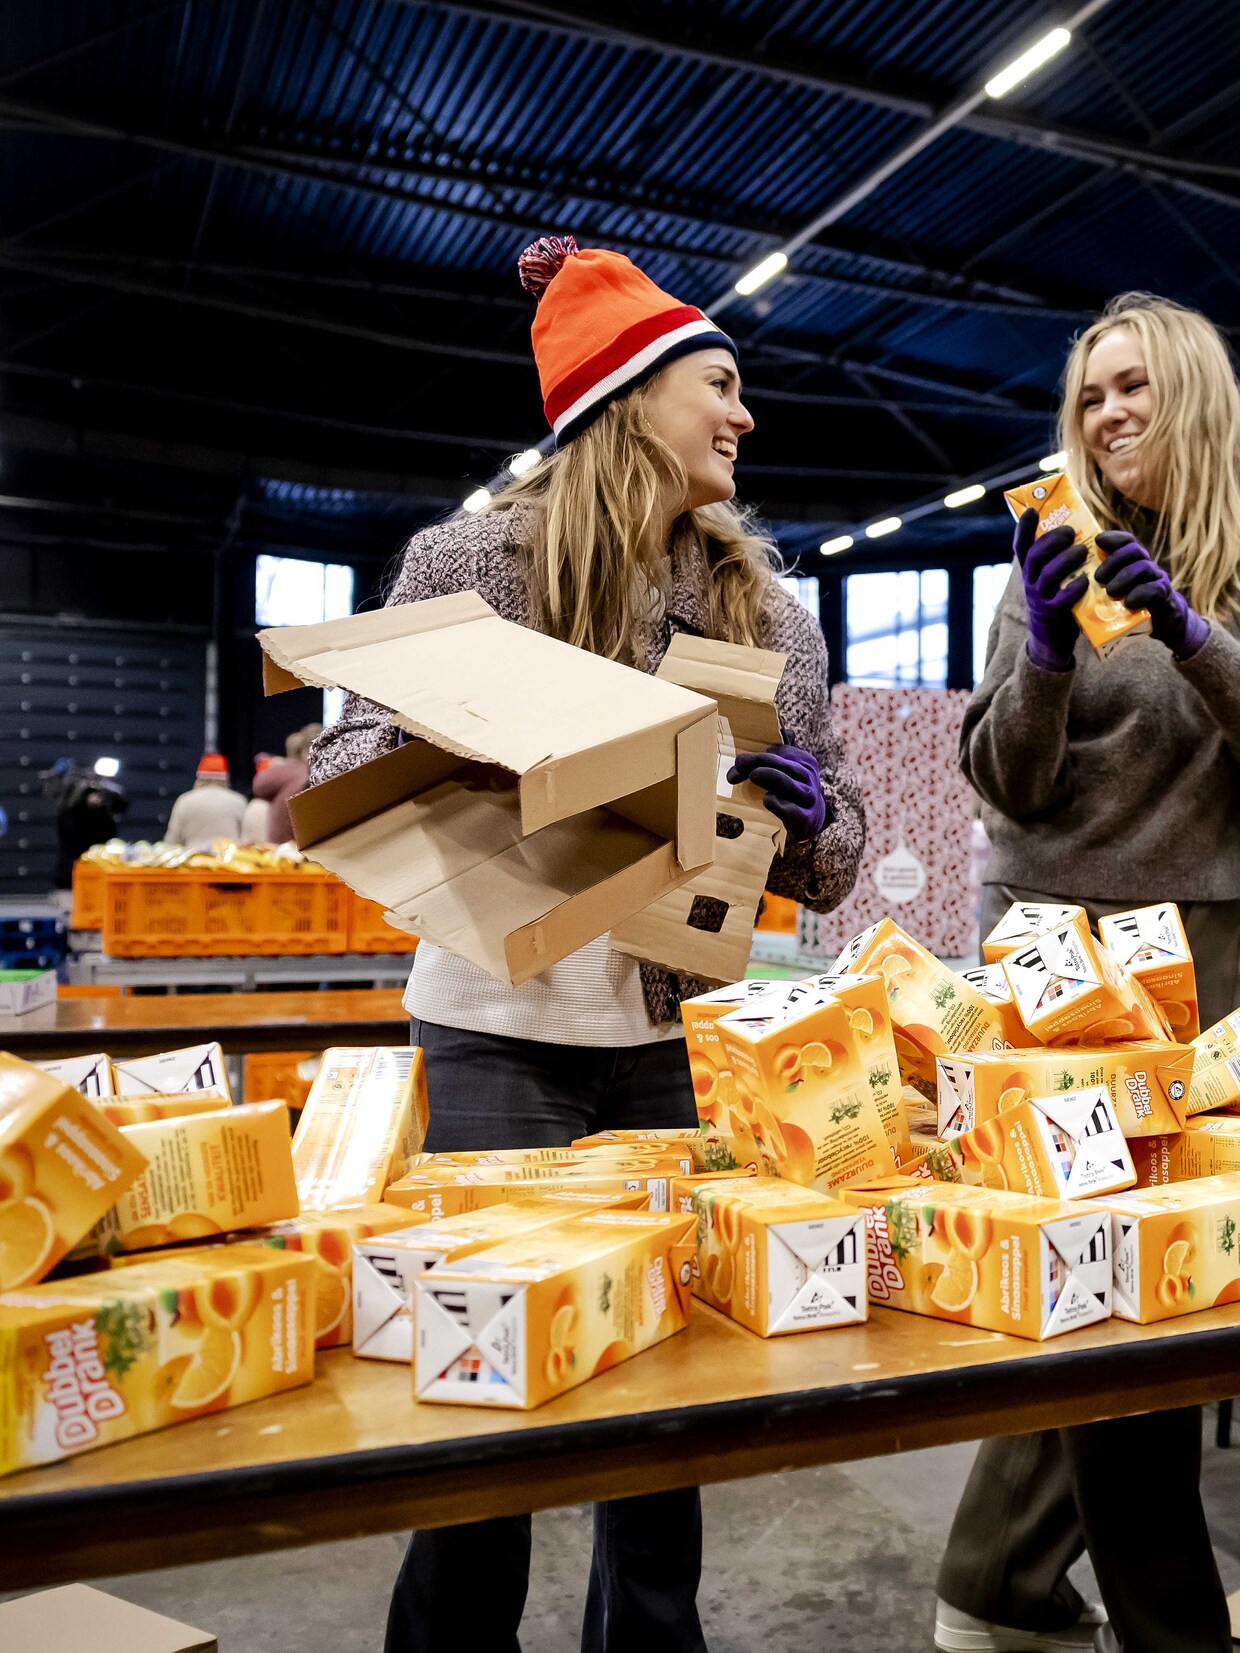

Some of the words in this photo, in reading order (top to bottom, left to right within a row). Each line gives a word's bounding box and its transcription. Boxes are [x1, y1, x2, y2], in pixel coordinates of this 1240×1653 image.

[945, 1000, 963, 1026] vermindering
[963, 1003, 975, 1018] 100%
[1045, 999, 1102, 1032] Sinaasappel
[1062, 1003, 1102, 1027] Abrikoos
[696, 1033, 704, 1043] &
[962, 1021, 981, 1050] VERPAKKING
[1126, 1076, 1146, 1119] Drank
[1134, 1071, 1153, 1116] Dubbel
[852, 1133, 870, 1146] 100%
[1009, 1128, 1017, 1139] &
[1148, 1139, 1157, 1149] &
[1014, 1120, 1043, 1196] Sinaasappel
[1015, 1141, 1035, 1195] Abrikoos
[1148, 1152, 1157, 1187] rikoos
[1160, 1135, 1169, 1184] asappel
[827, 1159, 874, 1189] DUURZAME
[411, 1200, 426, 1212] &
[868, 1206, 890, 1300] Dubbel
[871, 1204, 905, 1289] Drank
[1000, 1238, 1010, 1249] &
[1000, 1250, 1010, 1315] Abrikoos
[1010, 1235, 1021, 1321] Sinaasappel
[800, 1303, 817, 1312] Tetra
[1064, 1305, 1077, 1314] Tetra
[70, 1316, 125, 1422] Drank
[45, 1329, 97, 1450] Dubbel
